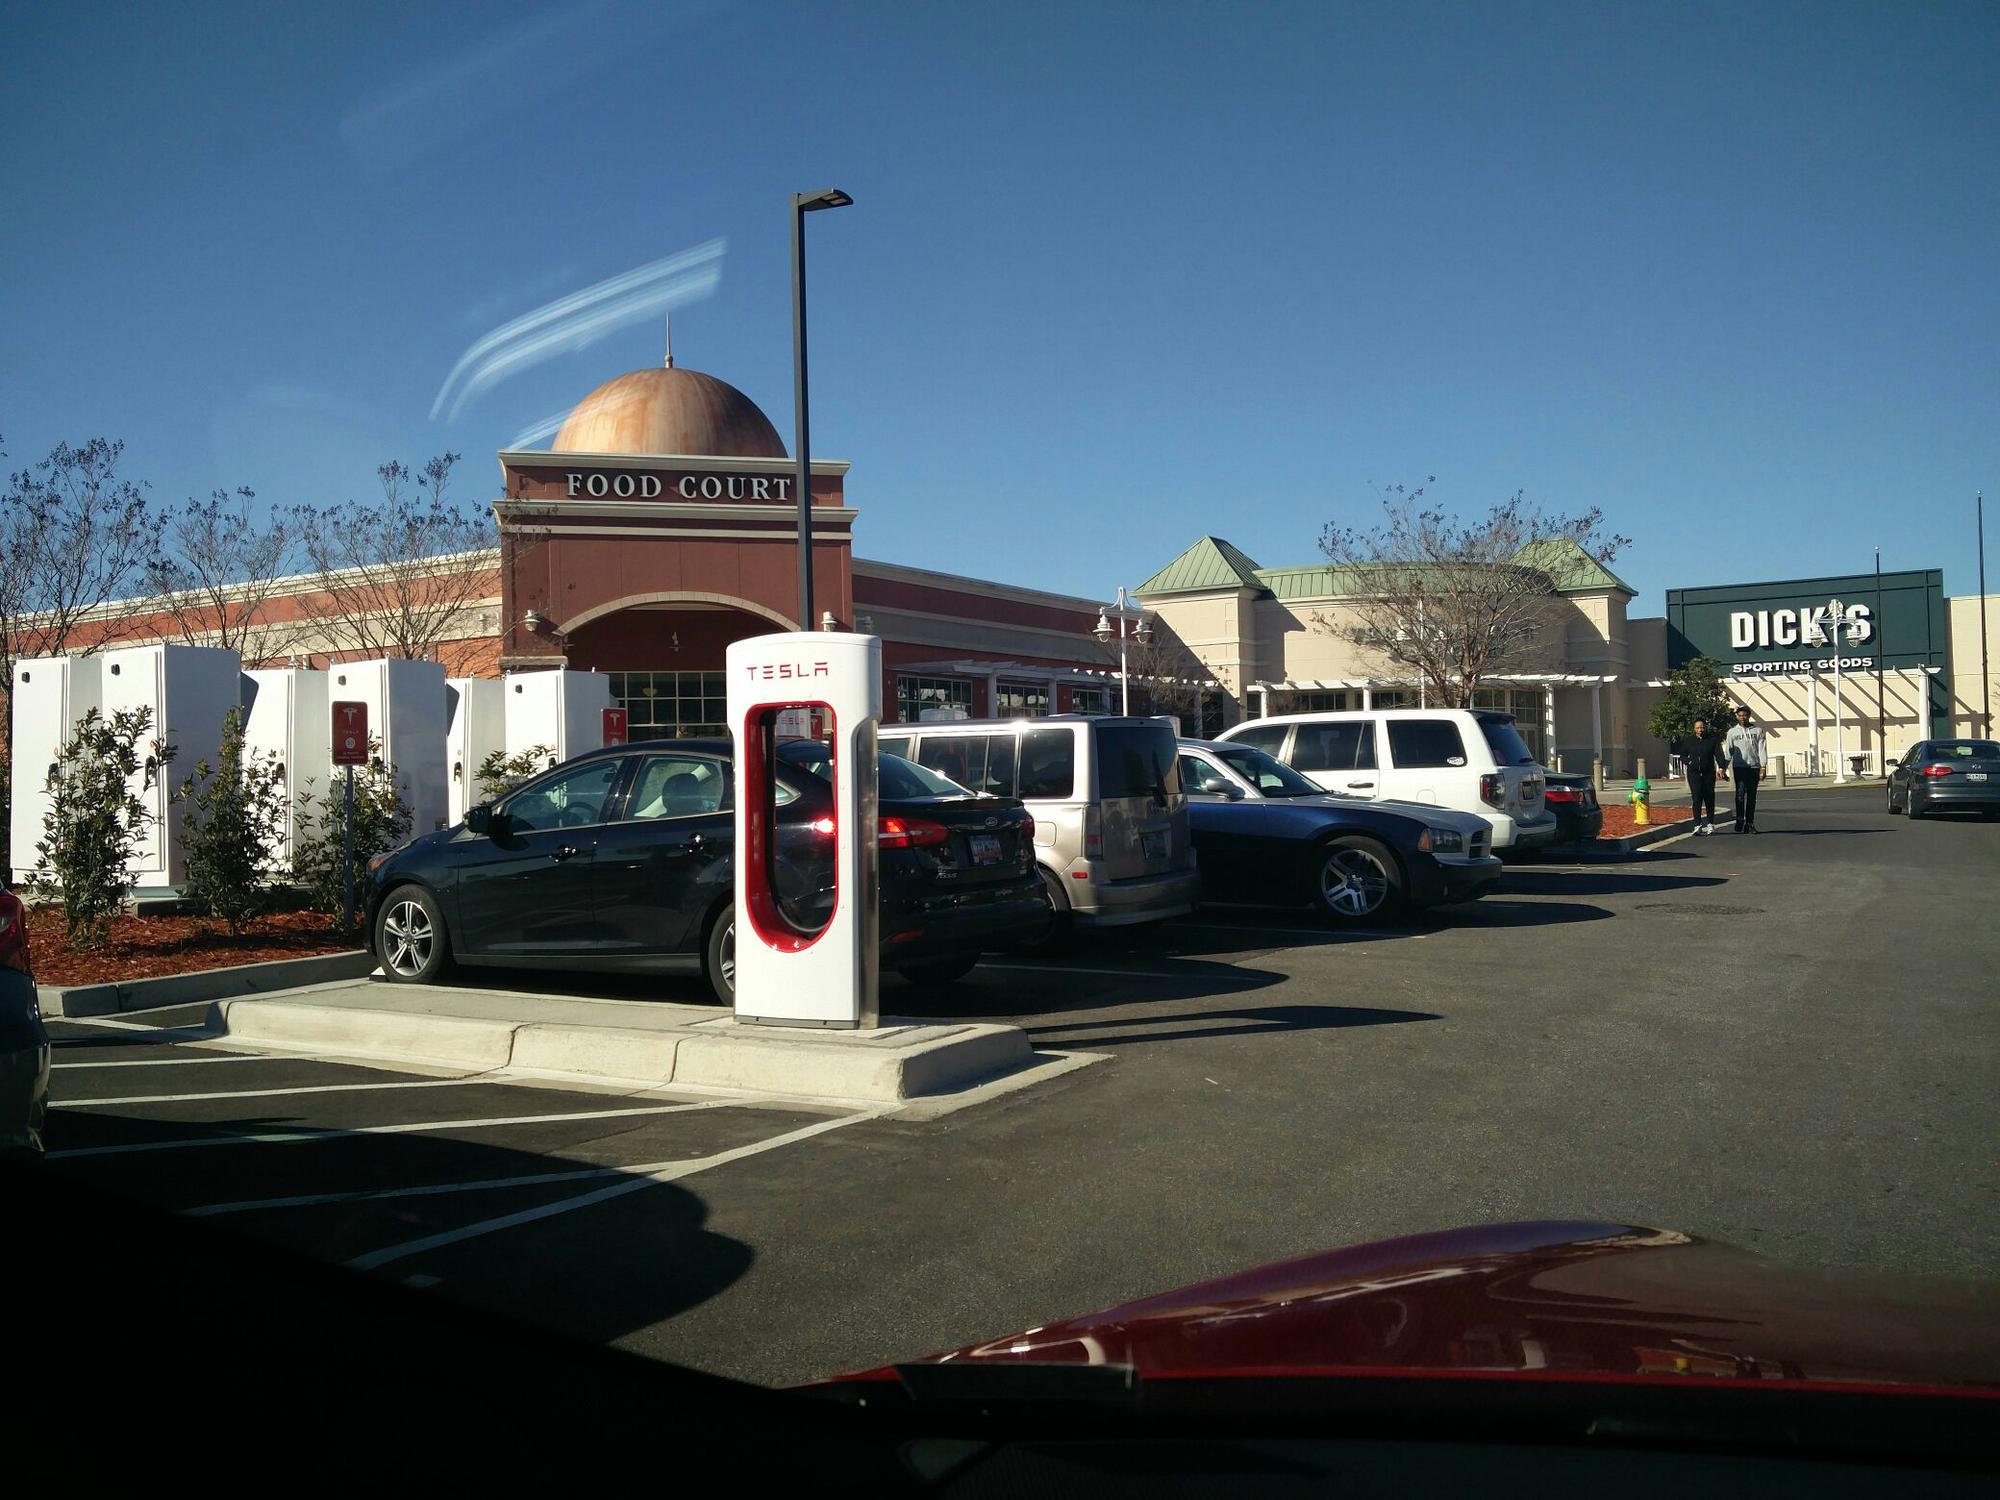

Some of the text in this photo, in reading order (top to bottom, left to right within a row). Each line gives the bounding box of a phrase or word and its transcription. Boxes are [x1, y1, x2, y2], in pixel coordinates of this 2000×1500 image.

[566, 474, 791, 500] FOOD COURT
[1730, 604, 1871, 648] DICKS
[746, 662, 828, 680] TESLA
[1732, 657, 1873, 673] SPORTING GOODS
